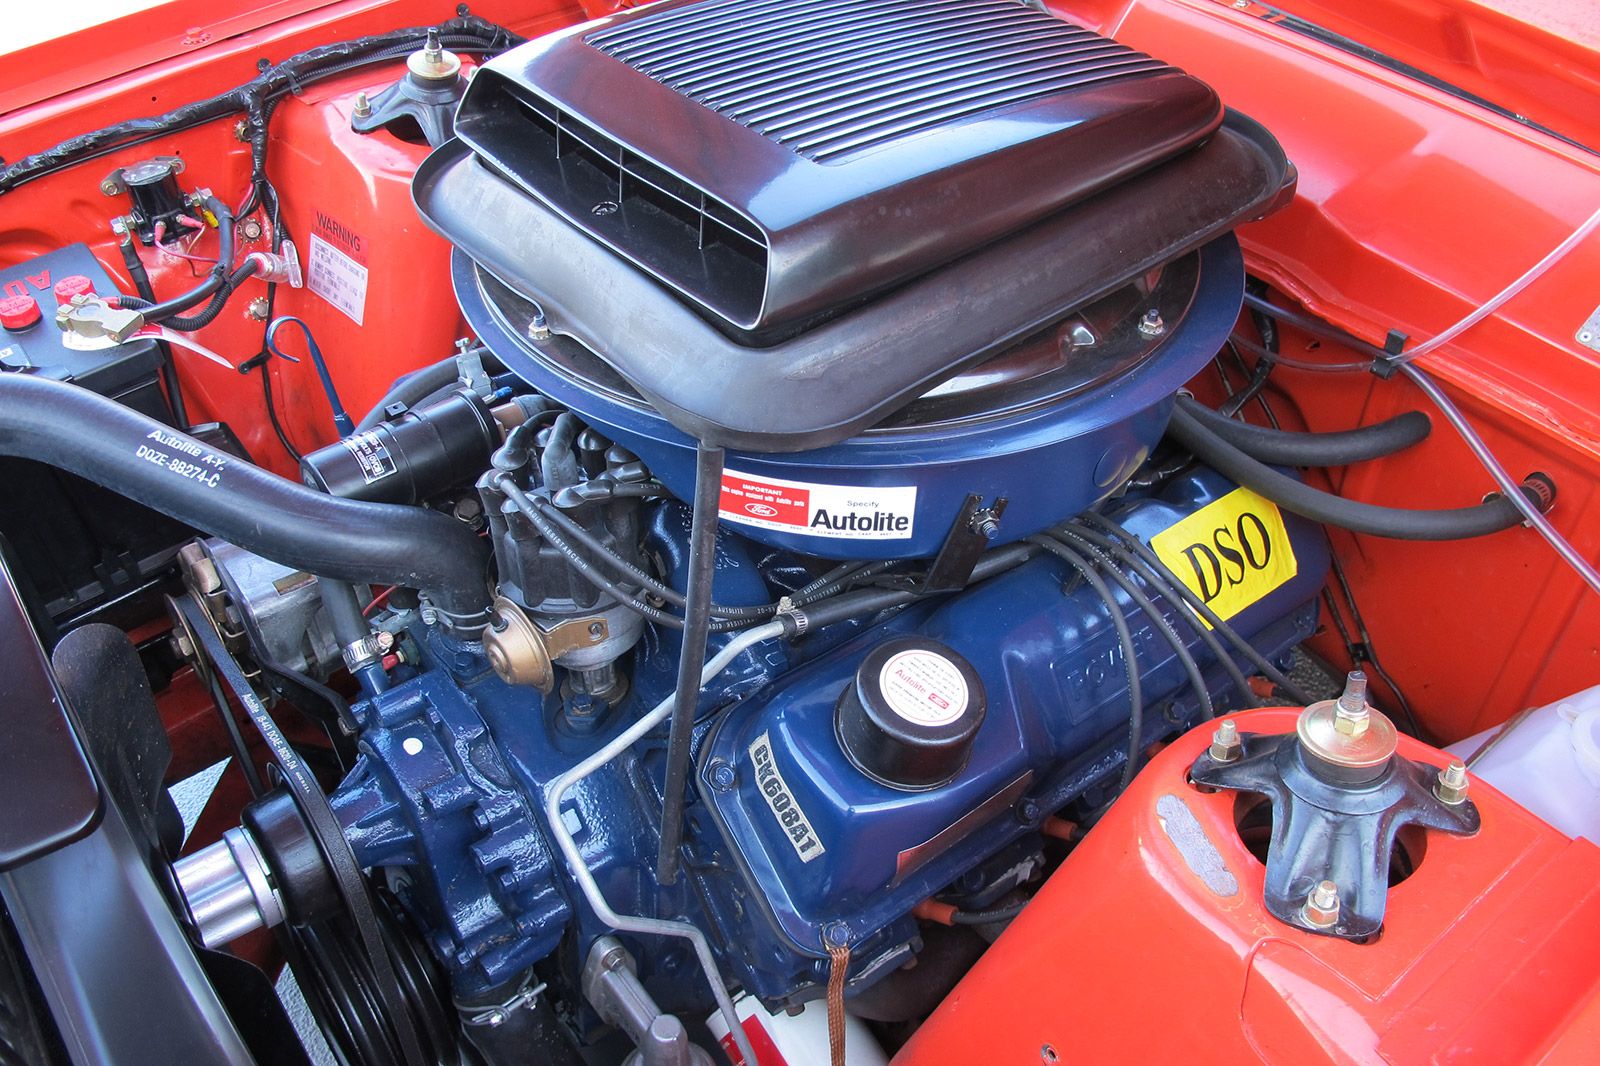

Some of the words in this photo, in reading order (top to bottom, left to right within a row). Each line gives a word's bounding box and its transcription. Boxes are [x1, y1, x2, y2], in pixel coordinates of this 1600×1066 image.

[316, 211, 361, 252] WARNING
[147, 429, 202, 457] Autolite
[742, 483, 783, 496] IMPORTANT
[751, 504, 772, 515] Ford
[847, 500, 880, 508] Specify
[810, 508, 909, 532] Autolite
[1180, 512, 1271, 604] DSO
[803, 578, 827, 595] AUTOLITE
[631, 599, 661, 618] AUTOLITE
[717, 607, 744, 615] AUTOLITE
[895, 669, 927, 694] Autolite
[753, 744, 817, 854] CK608A1
